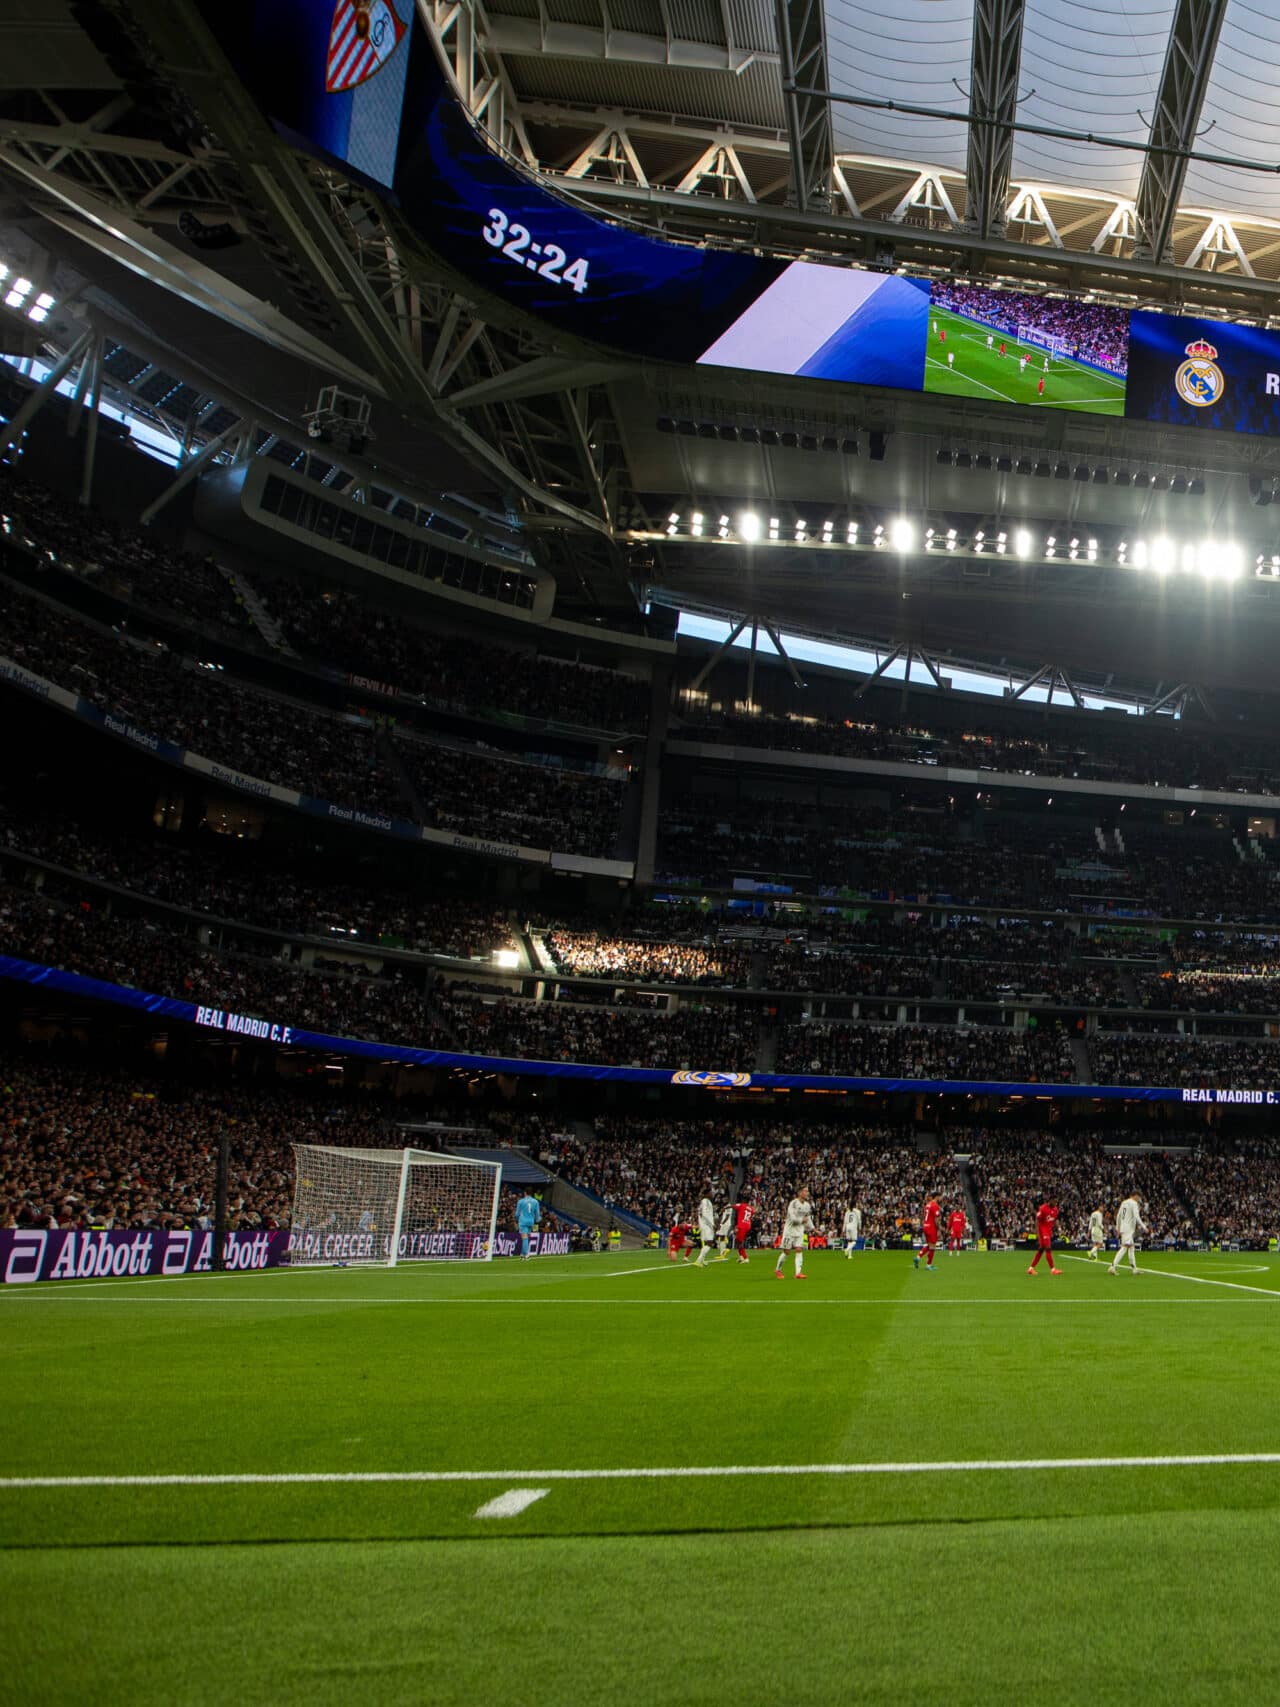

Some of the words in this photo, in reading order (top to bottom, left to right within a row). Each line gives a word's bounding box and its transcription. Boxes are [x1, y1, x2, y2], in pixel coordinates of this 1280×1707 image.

[482, 208, 589, 294] 32:24
[104, 715, 126, 732] Real
[127, 725, 158, 751] Madrid
[211, 766, 233, 784] Real
[235, 775, 271, 796] Madrid
[329, 805, 353, 820] Real
[355, 812, 391, 830] Madrid
[454, 837, 478, 851] Real
[480, 841, 519, 857] Madrid
[195, 1005, 224, 1029] REAL
[226, 1013, 270, 1039] MADRID
[270, 1024, 281, 1042] C.
[282, 1026, 292, 1044] F.
[1182, 1089, 1213, 1102] REAL
[1216, 1090, 1263, 1103] MADRID
[1266, 1091, 1279, 1104] C.
[527, 1203, 532, 1213] 1
[50, 1231, 153, 1279] Abbott
[193, 1232, 271, 1272] Abott
[287, 1233, 321, 1258] PARA
[325, 1233, 373, 1258] CRECER
[410, 1234, 418, 1254] Y
[418, 1234, 456, 1255] FUERTE
[540, 1232, 571, 1256] Abbott
